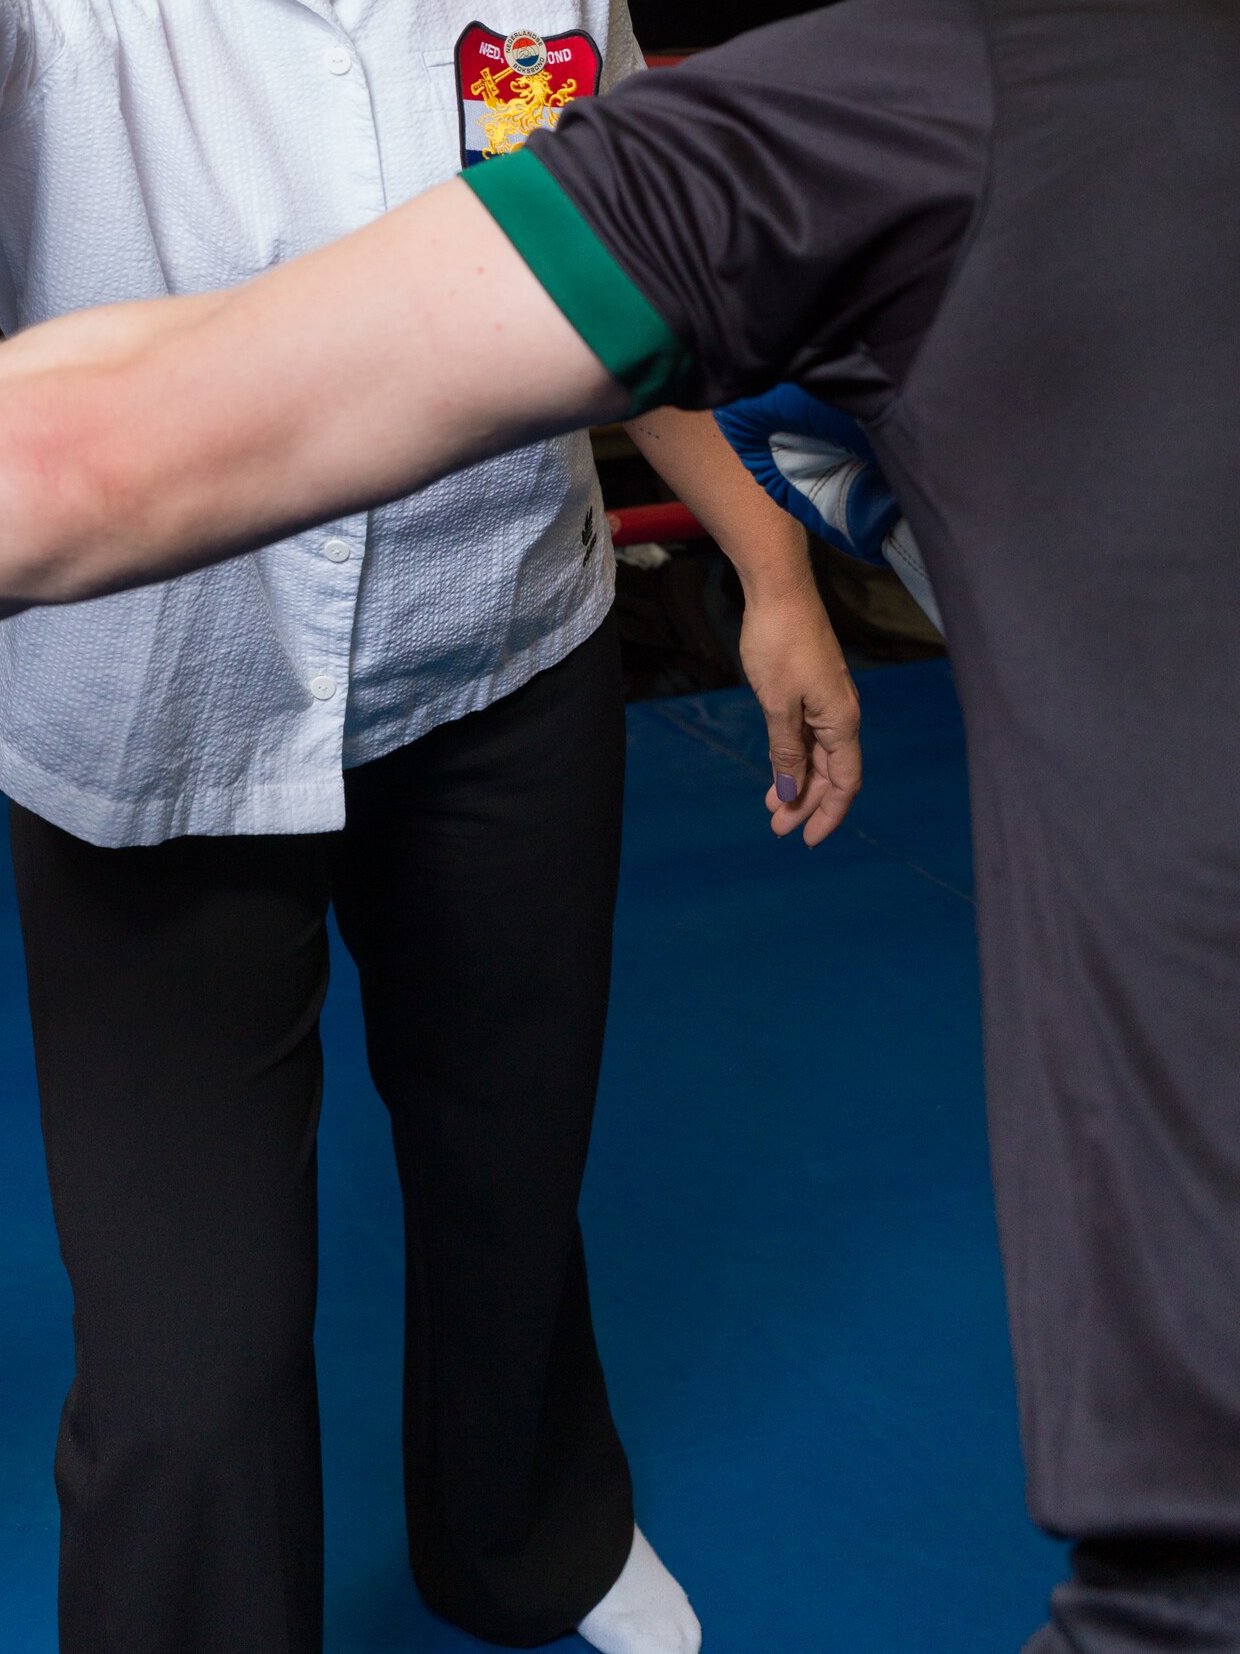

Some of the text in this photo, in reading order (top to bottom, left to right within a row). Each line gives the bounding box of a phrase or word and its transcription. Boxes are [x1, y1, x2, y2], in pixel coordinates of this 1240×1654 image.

[506, 30, 544, 54] NEDERLANDSE
[513, 56, 545, 74] BOKSBOND
[546, 48, 572, 64] OND
